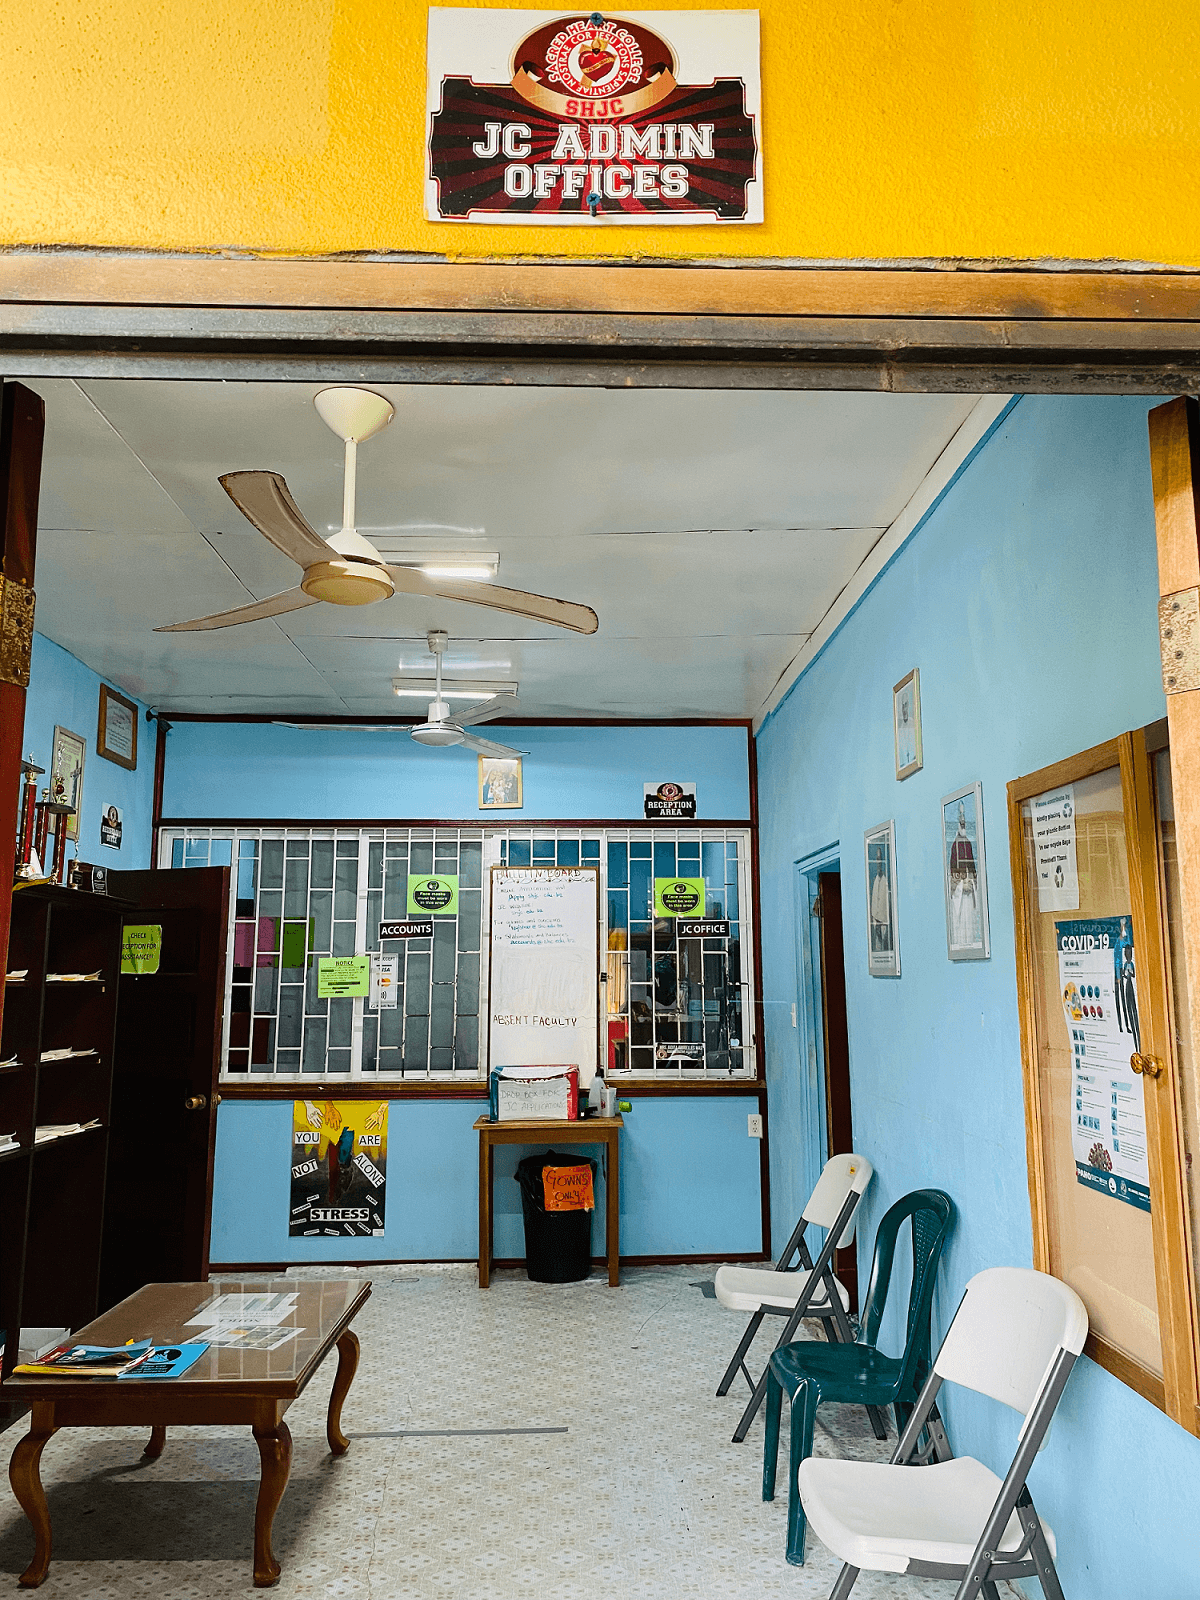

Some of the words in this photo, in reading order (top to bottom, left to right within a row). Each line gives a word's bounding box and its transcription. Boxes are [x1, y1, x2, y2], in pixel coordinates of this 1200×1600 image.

[571, 31, 592, 44] COR
[595, 31, 618, 44] JESU
[545, 31, 569, 83] SACRED
[566, 20, 617, 35] HEART
[616, 28, 643, 84] COLLEGE
[615, 43, 630, 69] FONS
[559, 45, 577, 87] NOSTRAE
[565, 98, 624, 117] SHJC
[472, 123, 531, 159] JC
[553, 123, 715, 159] ADMIN
[504, 163, 689, 199] OFFICES
[648, 801, 693, 809] RECEPTION
[547, 869, 581, 878] BOARD
[381, 924, 432, 936] ACCOUNTS
[682, 925, 692, 935] JC
[693, 924, 726, 934] OFFICE
[1061, 933, 1110, 951] COVID-19
[493, 1014, 528, 1026] ABSENT
[532, 1016, 577, 1027] FACULTY
[501, 1090, 520, 1099] DROP
[524, 1090, 539, 1098] BOX
[542, 1090, 560, 1098] FOR
[504, 1102, 518, 1111] JC
[296, 1133, 320, 1143] YOU
[359, 1135, 381, 1145] ARE
[293, 1160, 317, 1177] NOT
[355, 1154, 385, 1188] ALONE
[546, 1170, 588, 1189] GOWNS
[555, 1190, 580, 1203] ONLY
[311, 1209, 369, 1220] STRESS
